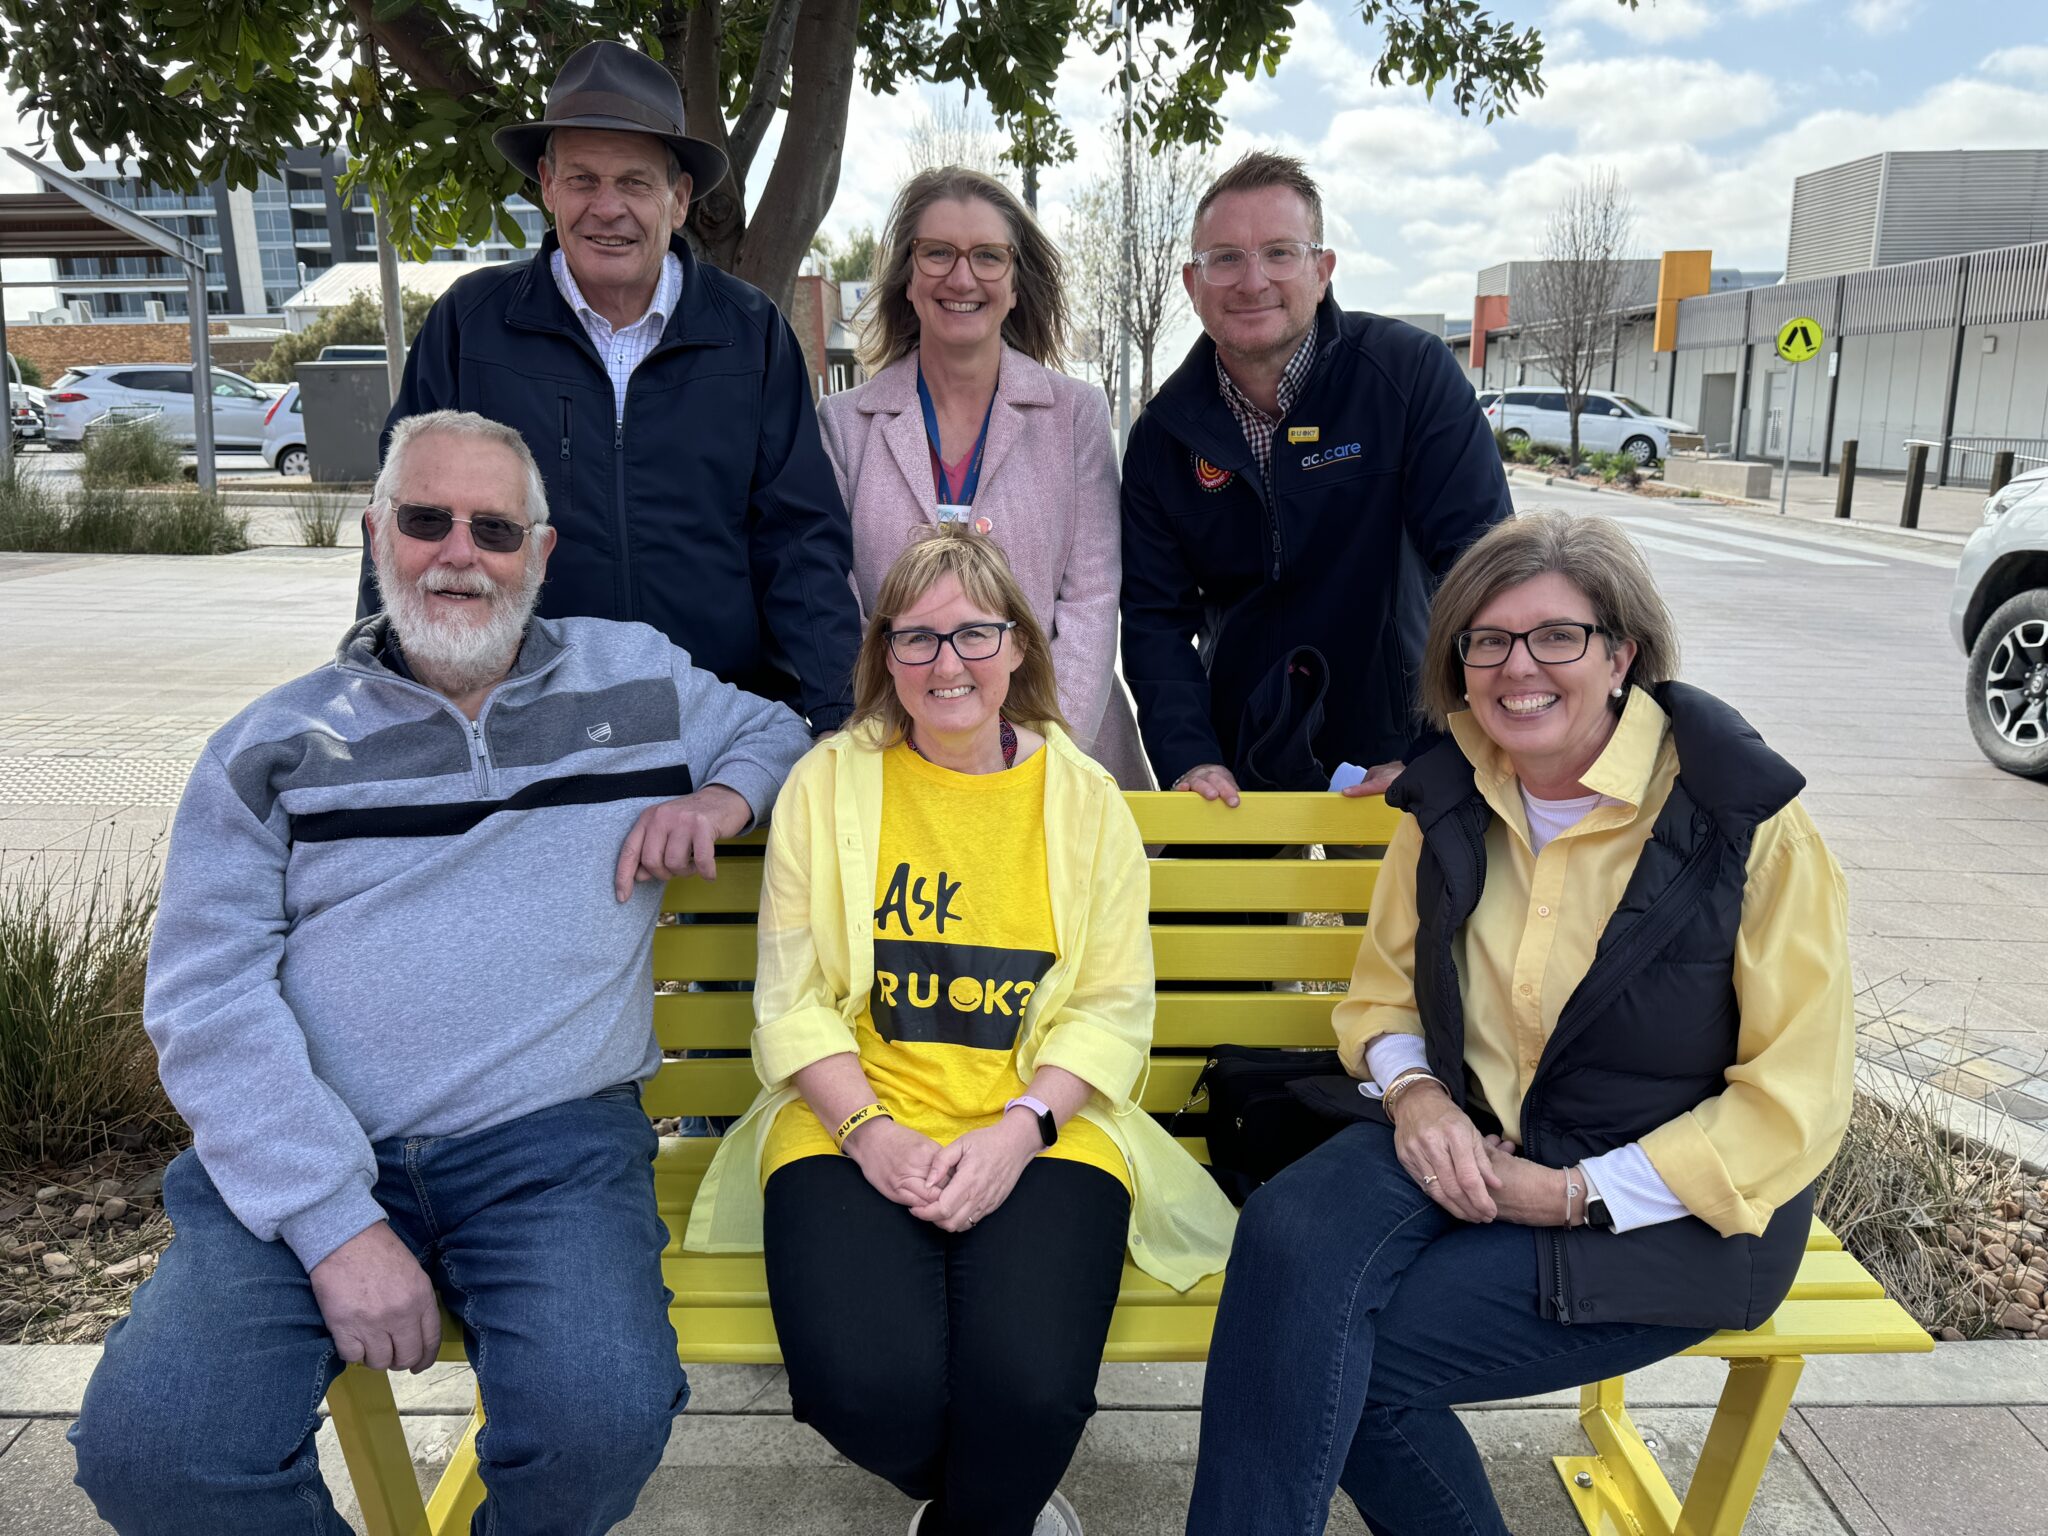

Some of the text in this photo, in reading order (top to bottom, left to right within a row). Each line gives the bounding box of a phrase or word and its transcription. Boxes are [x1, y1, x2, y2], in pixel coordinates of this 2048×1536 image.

[1301, 442, 1361, 467] ac.care
[873, 862, 963, 936] Ask
[876, 970, 899, 1007] R
[907, 971, 940, 1009] U
[837, 1129, 845, 1137] R
[842, 1121, 850, 1131] U
